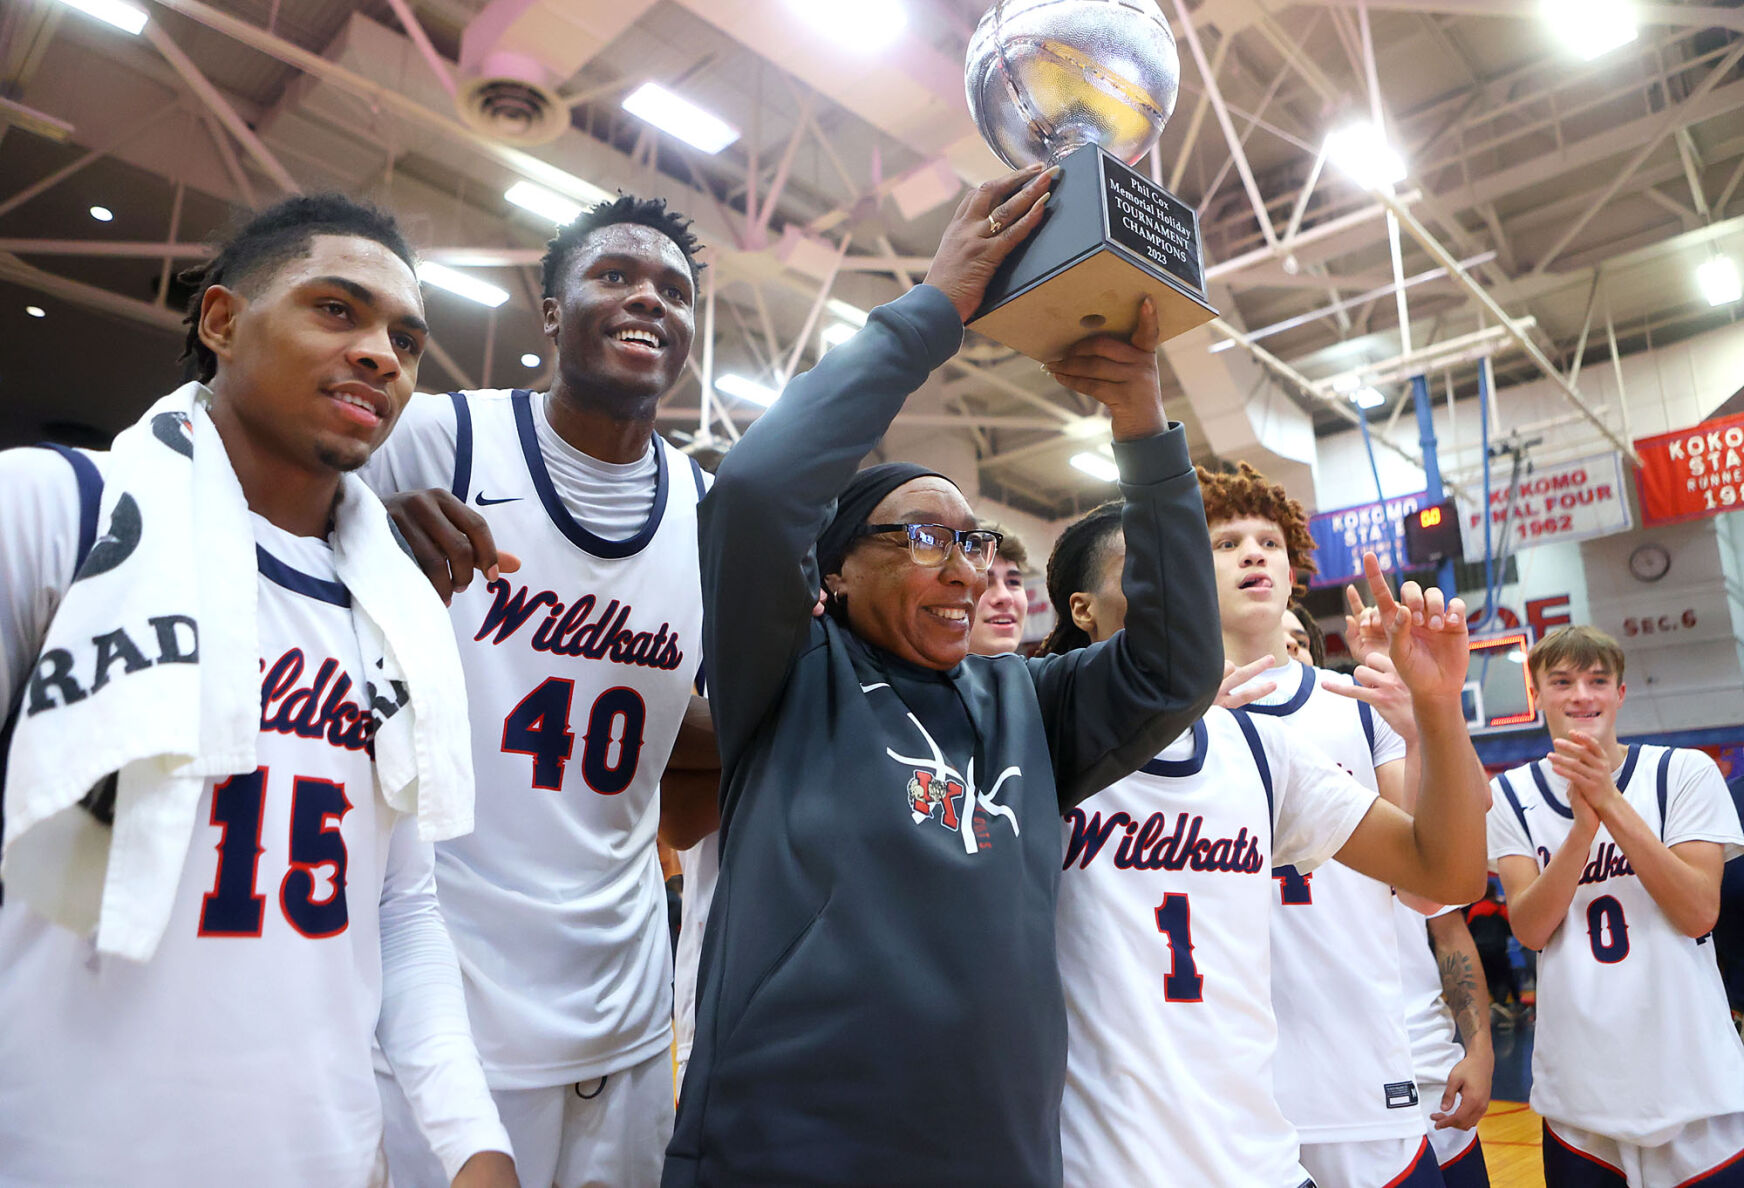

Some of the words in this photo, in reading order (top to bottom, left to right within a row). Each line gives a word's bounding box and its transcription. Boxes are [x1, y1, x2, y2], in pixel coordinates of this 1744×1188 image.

[1109, 178, 1154, 214] Memorial
[1156, 208, 1191, 240] Holiday
[1130, 178, 1150, 197] Phil
[1151, 192, 1169, 210] Cox
[1115, 196, 1190, 249] TOURNAMENT
[1122, 216, 1187, 263] CHAMPIONS
[1147, 246, 1167, 265] 2023
[1689, 446, 1744, 476] STA
[1344, 517, 1406, 547] STAE
[1470, 503, 1539, 529] FNAL
[1545, 485, 1614, 512] FOUR
[1517, 513, 1573, 540] 1962
[474, 577, 683, 671] Wildkats
[500, 676, 645, 796] 40
[197, 766, 354, 940] 15
[1063, 806, 1264, 874] Wildkats
[1154, 892, 1204, 1002] 1
[1586, 894, 1630, 964] 0
